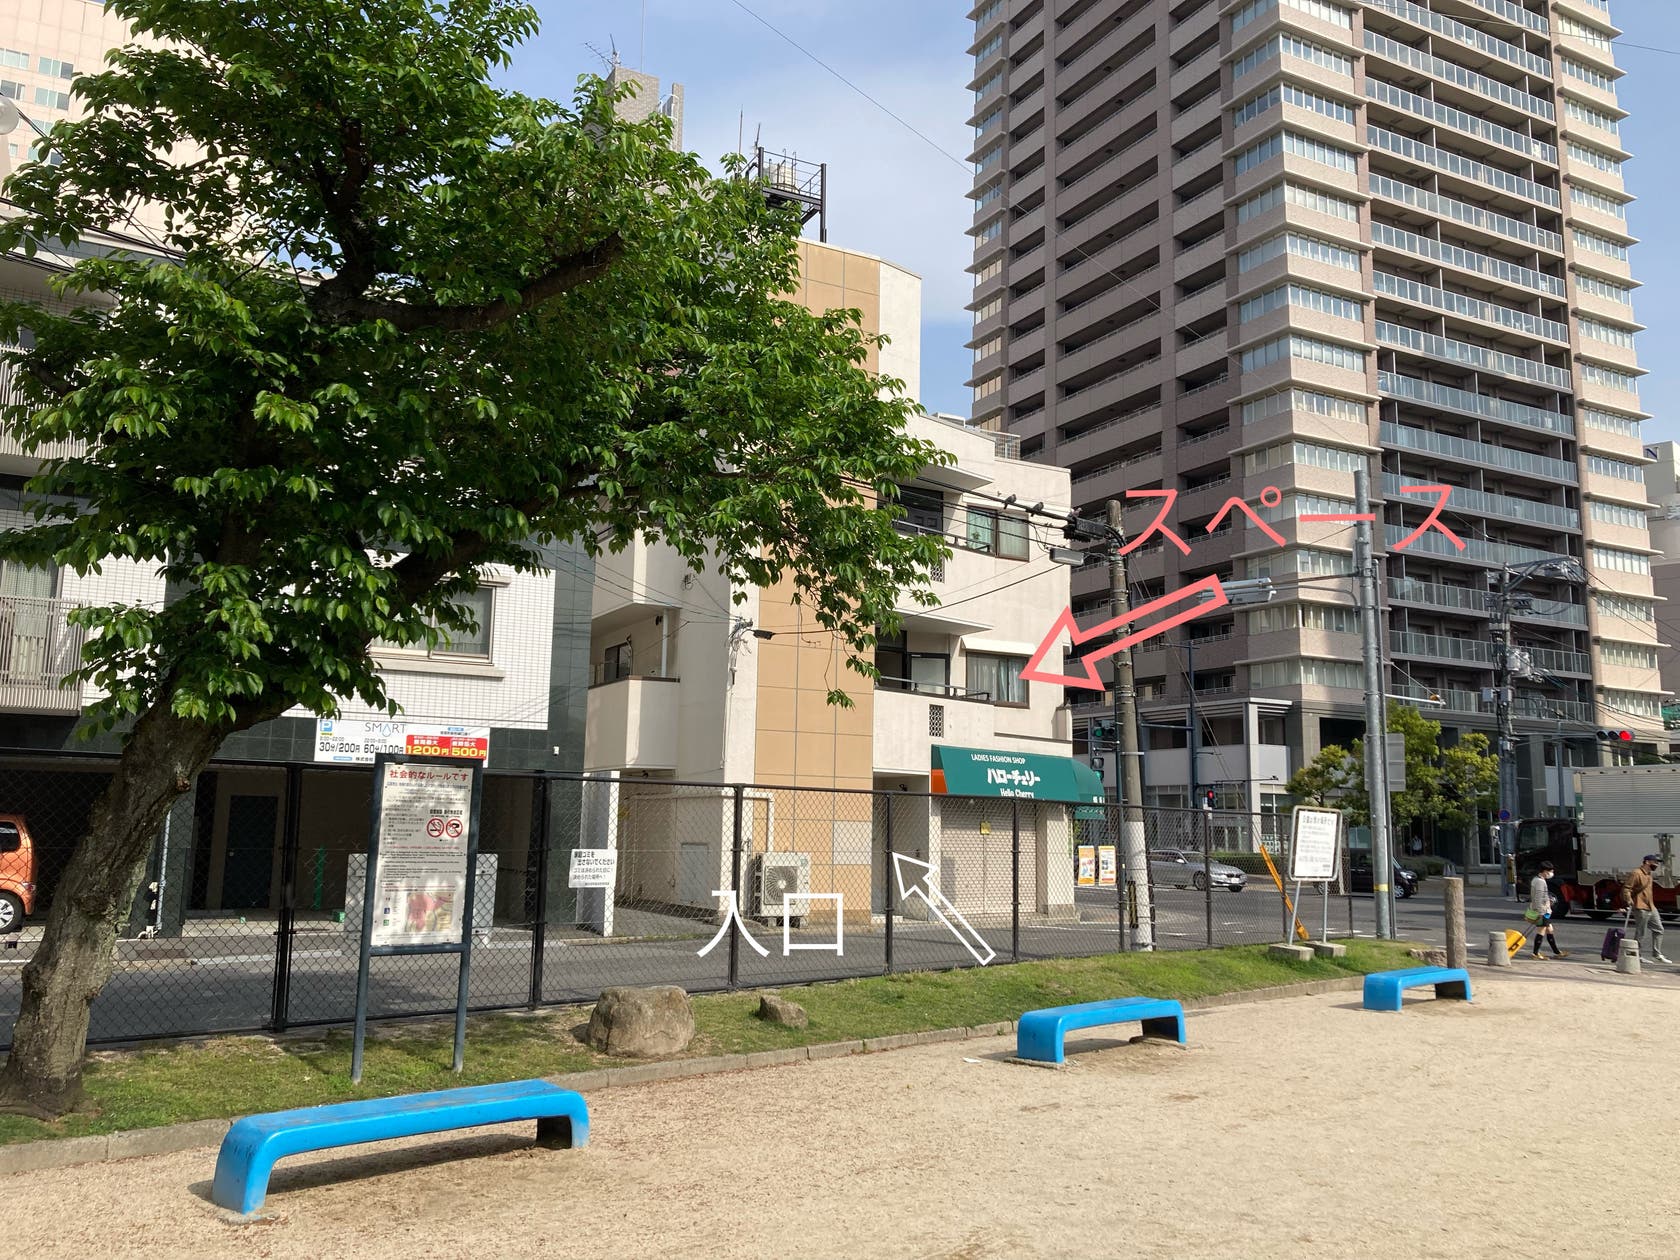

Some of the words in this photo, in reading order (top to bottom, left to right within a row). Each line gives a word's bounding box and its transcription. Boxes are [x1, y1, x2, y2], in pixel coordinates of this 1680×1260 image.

[320, 721, 332, 731] P
[319, 742, 360, 753] 30分/200円
[406, 746, 449, 756] 1200円
[452, 747, 486, 757] 500円
[971, 754, 989, 762] LADIES
[989, 755, 1011, 763] FASHION
[1011, 756, 1026, 764] SHOP
[389, 770, 468, 781] 社会的なルールです
[987, 768, 1040, 787] ハローチェリー
[1000, 788, 1014, 797] Hello
[1015, 789, 1034, 799] Cherry
